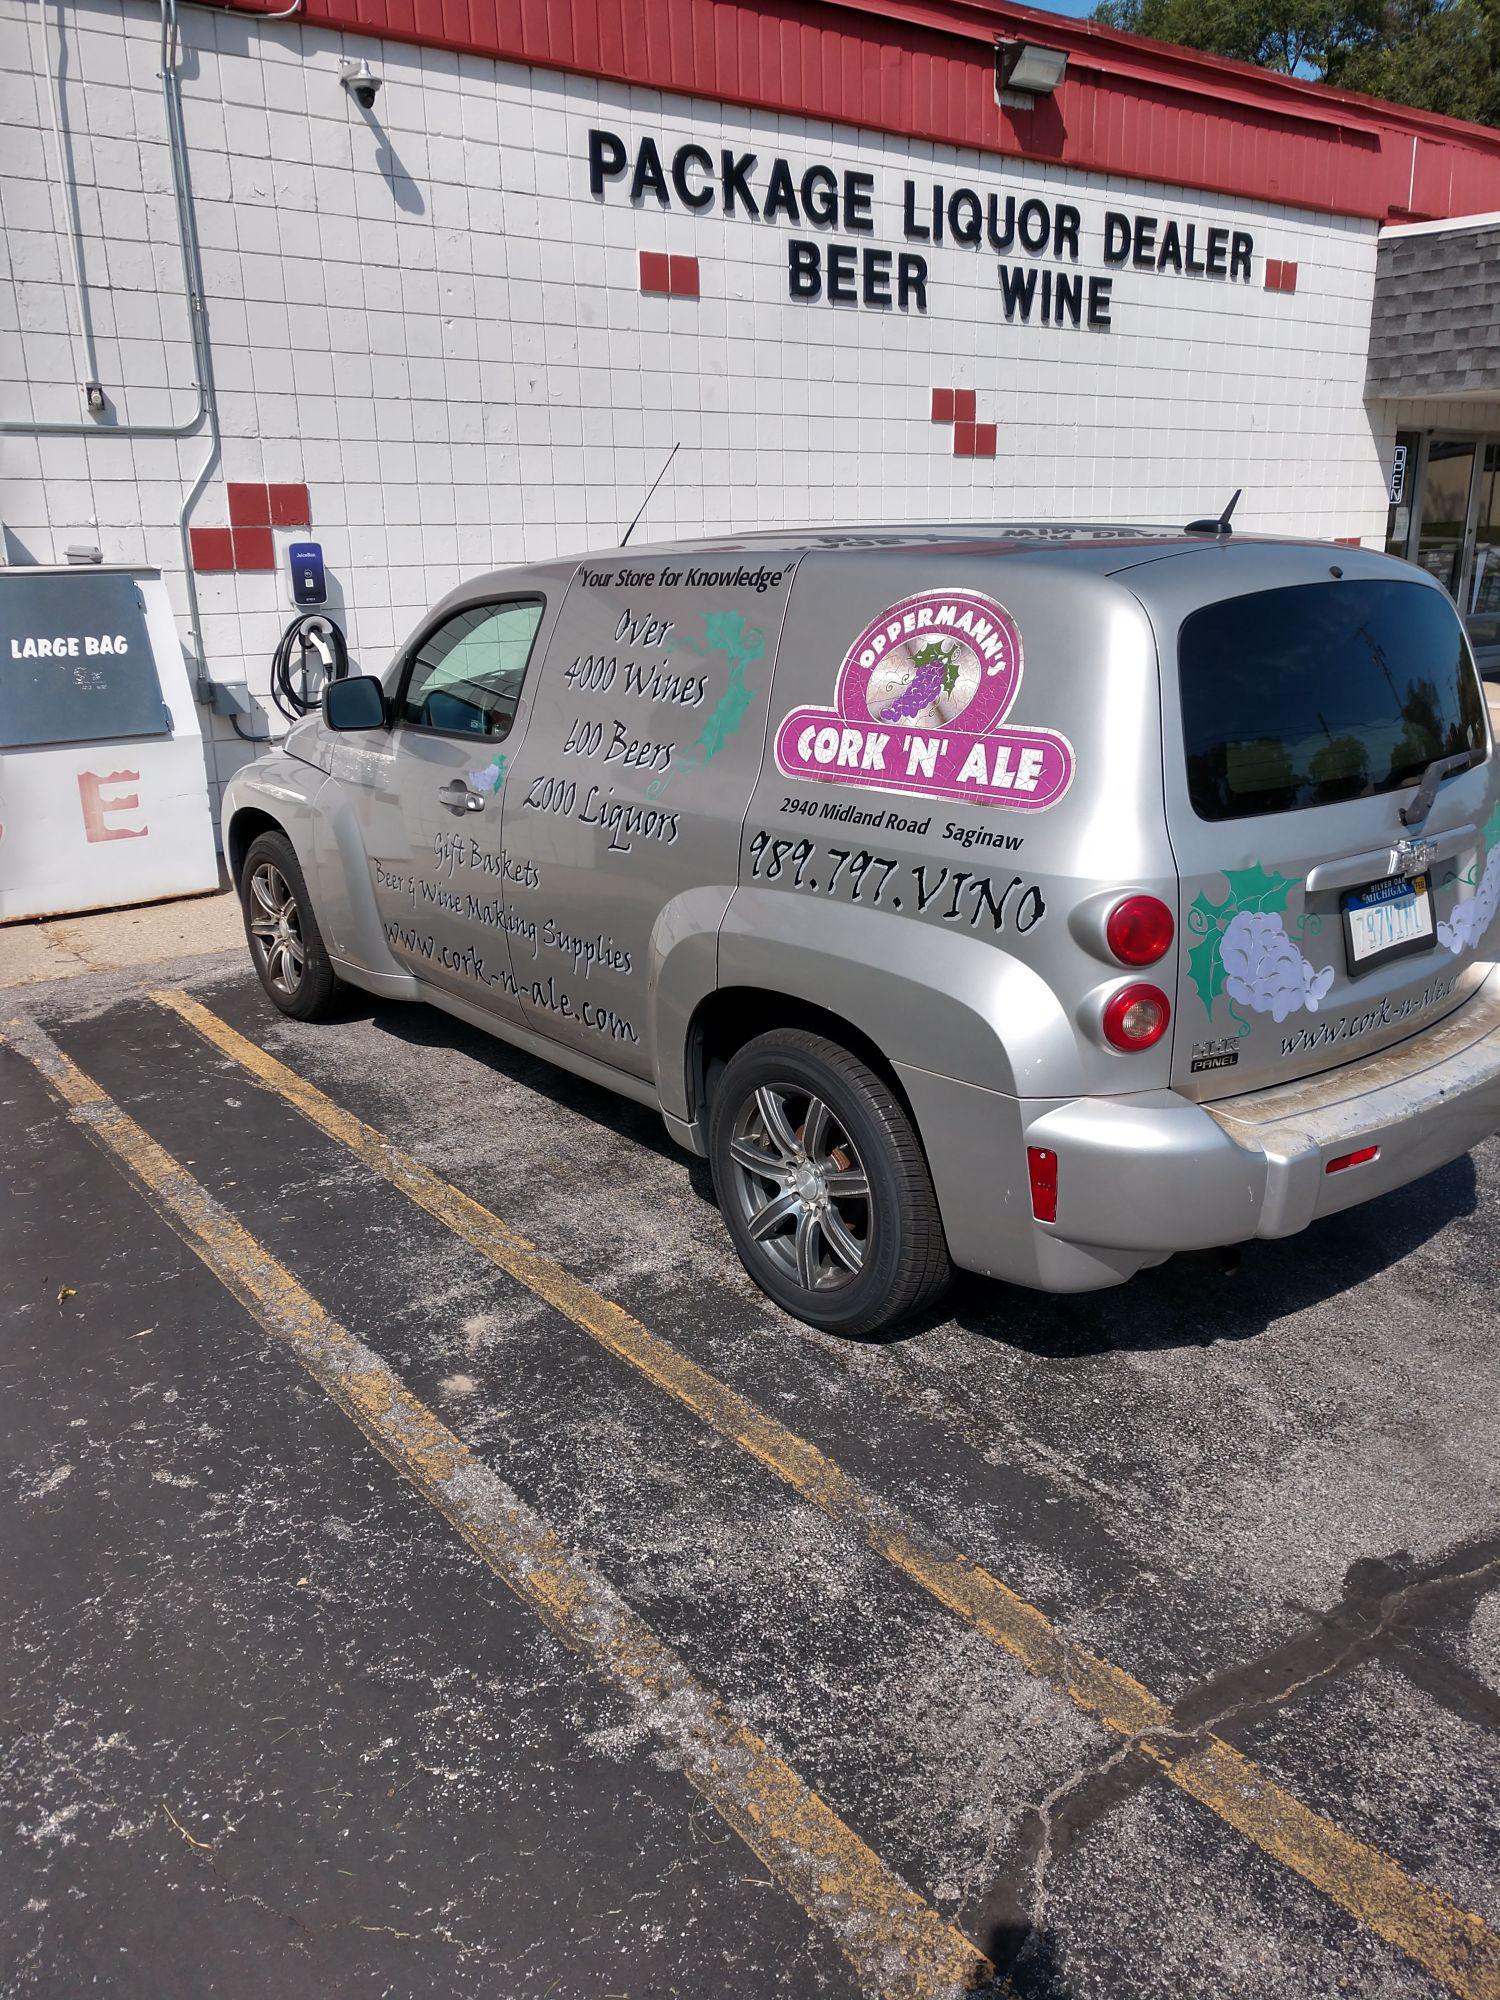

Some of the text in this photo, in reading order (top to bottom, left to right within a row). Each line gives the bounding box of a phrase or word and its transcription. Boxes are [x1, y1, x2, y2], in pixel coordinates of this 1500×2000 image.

[588, 128, 1254, 279] PACKAGE LIQUOR DEALER
[788, 239, 1113, 326] BEER WINE
[1390, 447, 1405, 502] OPEN
[615, 568, 655, 588] Store
[659, 566, 683, 588] for
[11, 635, 128, 659] LARGE BAG
[614, 608, 674, 648] Over
[859, 605, 1007, 677] OPPERMANN'S
[564, 655, 709, 708] 4000 Wines
[563, 718, 676, 774] 600 Beers
[797, 724, 1044, 792] CORK 'N' ALE
[523, 775, 680, 853] 2000 Liquors
[780, 797, 1025, 852] 2940 Midland Road Saginaw
[434, 832, 540, 890] Gift Baskets
[750, 830, 1047, 936] 989.797.VINO
[374, 857, 633, 980] Beer & Wine Making Supplies
[1365, 883, 1408, 904] MICHIGAN
[384, 922, 640, 1045] www.cork-n-ale.com
[1193, 1055, 1237, 1071] PANEL
